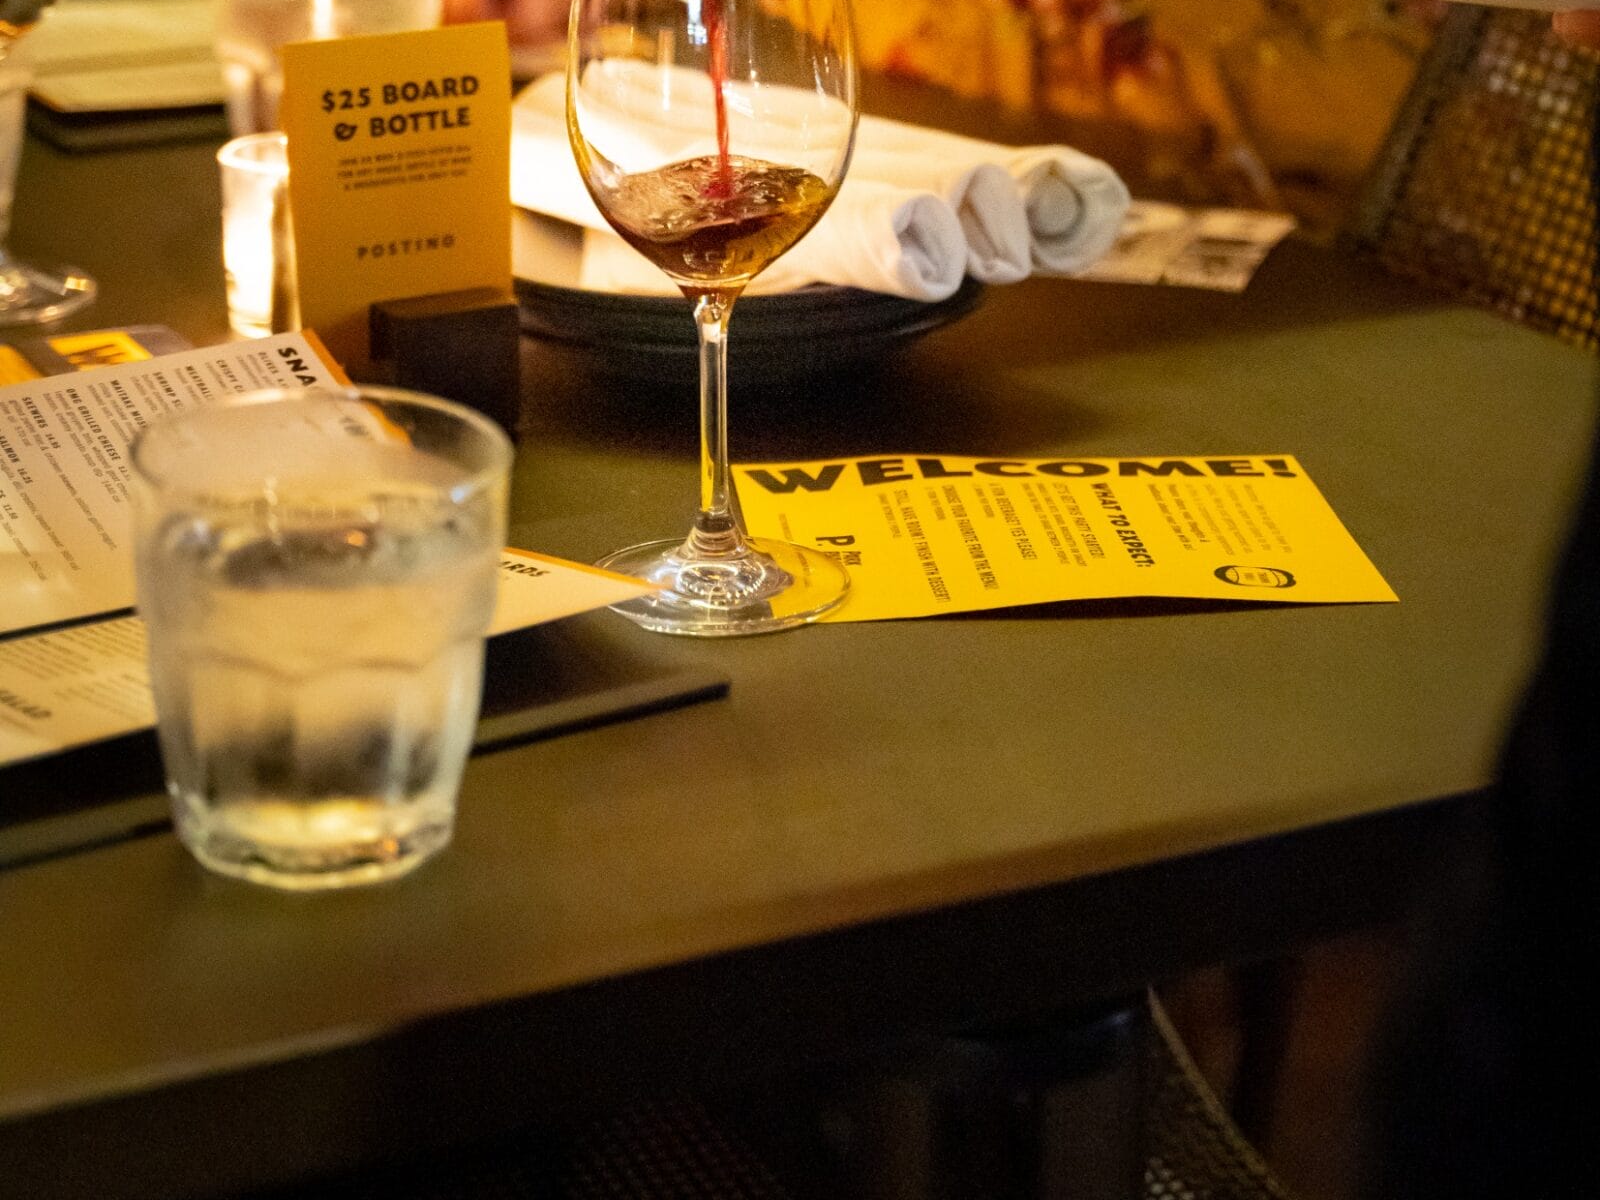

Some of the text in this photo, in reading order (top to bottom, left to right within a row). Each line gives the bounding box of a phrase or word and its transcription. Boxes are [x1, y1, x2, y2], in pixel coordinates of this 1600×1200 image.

[321, 75, 479, 113] $25 BOARD
[333, 107, 471, 142] & BOTTLE
[277, 347, 317, 387] SNA
[22, 396, 48, 428] SKEWERS
[66, 388, 82, 404] OMG
[77, 405, 102, 434] GRILLED
[97, 435, 121, 460] CHEESE
[745, 458, 1297, 494] WELCOME!
[1091, 483, 1122, 511] WHAT
[1107, 515, 1130, 527] TO
[1010, 527, 1026, 537] YES
[914, 541, 933, 561] FINISH
[966, 543, 986, 559] FROM
[974, 559, 991, 571] THE
[922, 561, 940, 576] WITH
